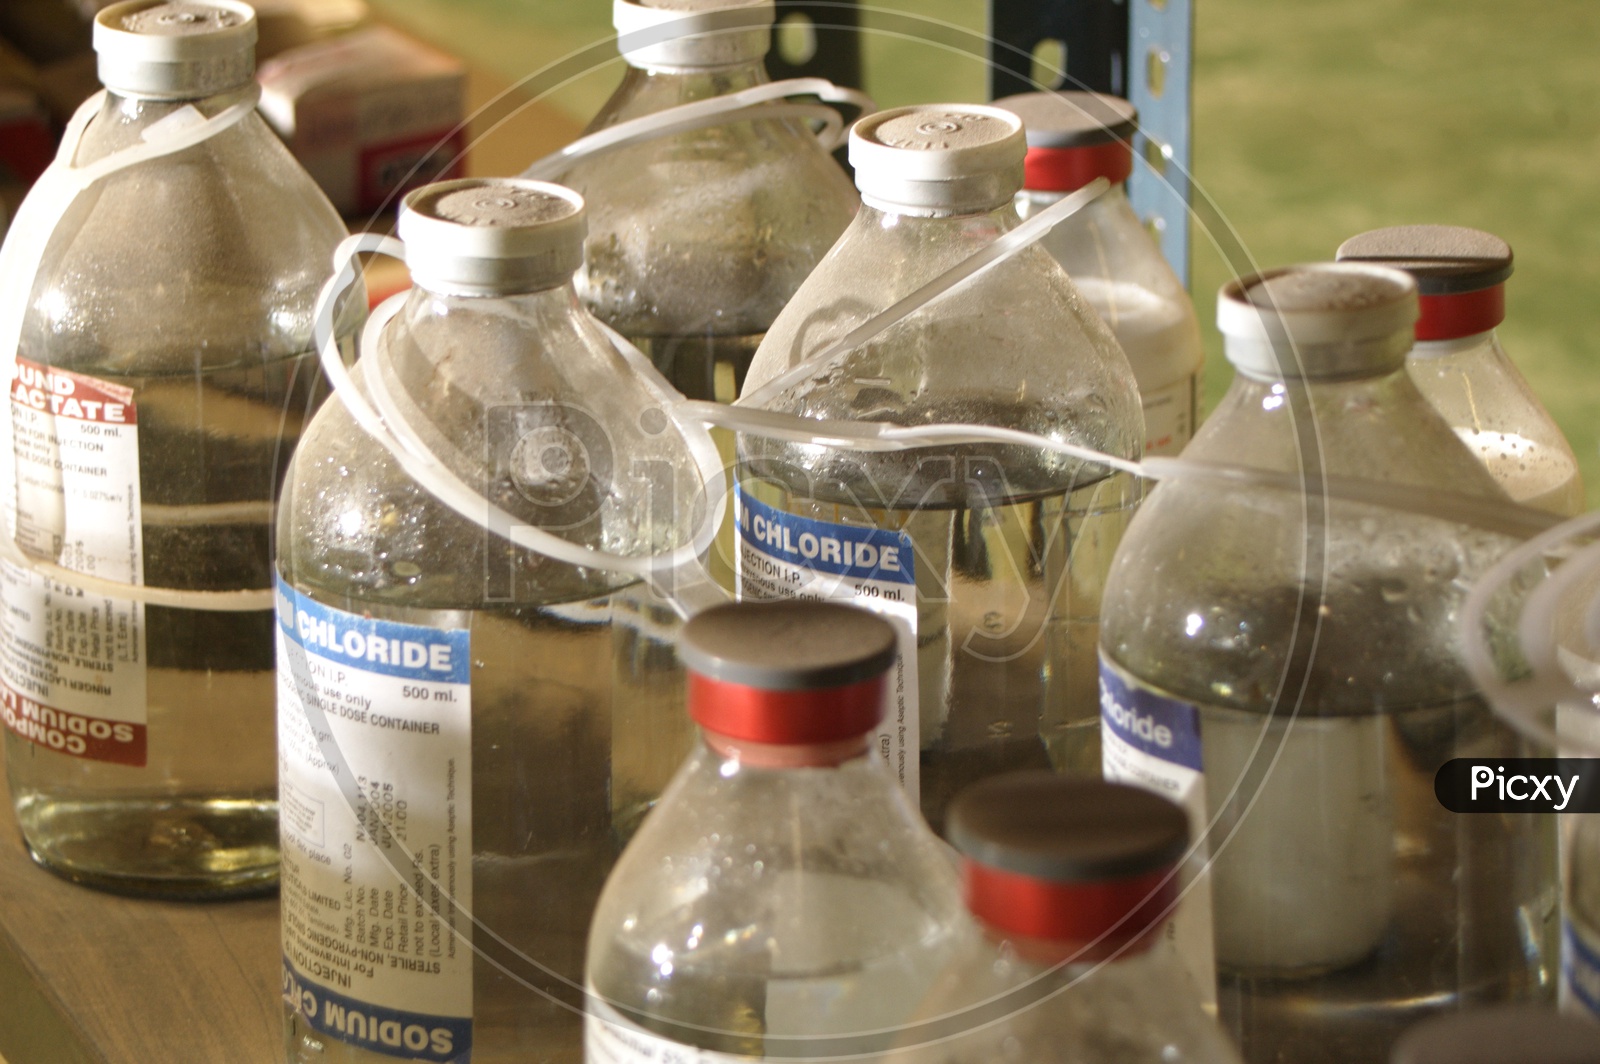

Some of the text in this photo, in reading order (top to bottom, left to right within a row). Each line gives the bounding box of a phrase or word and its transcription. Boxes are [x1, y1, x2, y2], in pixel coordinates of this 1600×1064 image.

[54, 459, 108, 477] CONTAINER
[753, 514, 900, 572] CHLORIDE
[784, 569, 803, 587] I.P.
[778, 586, 797, 599] use
[854, 583, 906, 602] 500 ml.
[296, 609, 453, 672] CHLORIDE
[69, 679, 112, 696] RINGER
[323, 684, 342, 701] use
[345, 693, 372, 712] only
[402, 685, 458, 703] 500 ml.
[22, 698, 135, 743] SODIUM
[306, 692, 338, 716] SINGLE
[339, 705, 368, 724] DOSE
[370, 714, 441, 735] CONTAINER
[343, 863, 354, 885] No.
[428, 843, 442, 880] extra)
[308, 888, 341, 911] LIMITED
[355, 884, 366, 906] No.
[368, 887, 379, 917] Date
[383, 889, 394, 919] Date
[397, 883, 408, 915] Price
[413, 872, 424, 918] exceed
[355, 908, 366, 945] Batch
[368, 921, 381, 948] Mfg.
[383, 924, 395, 950] Exp.
[397, 917, 408, 953] Retail
[413, 921, 424, 934] to
[429, 920, 442, 958] (Local
[306, 926, 384, 966] NON-PYROGENIC
[413, 936, 424, 956] not
[354, 962, 374, 979] For
[386, 952, 441, 975] STERILE,
[324, 1001, 454, 1055] SODIUM
